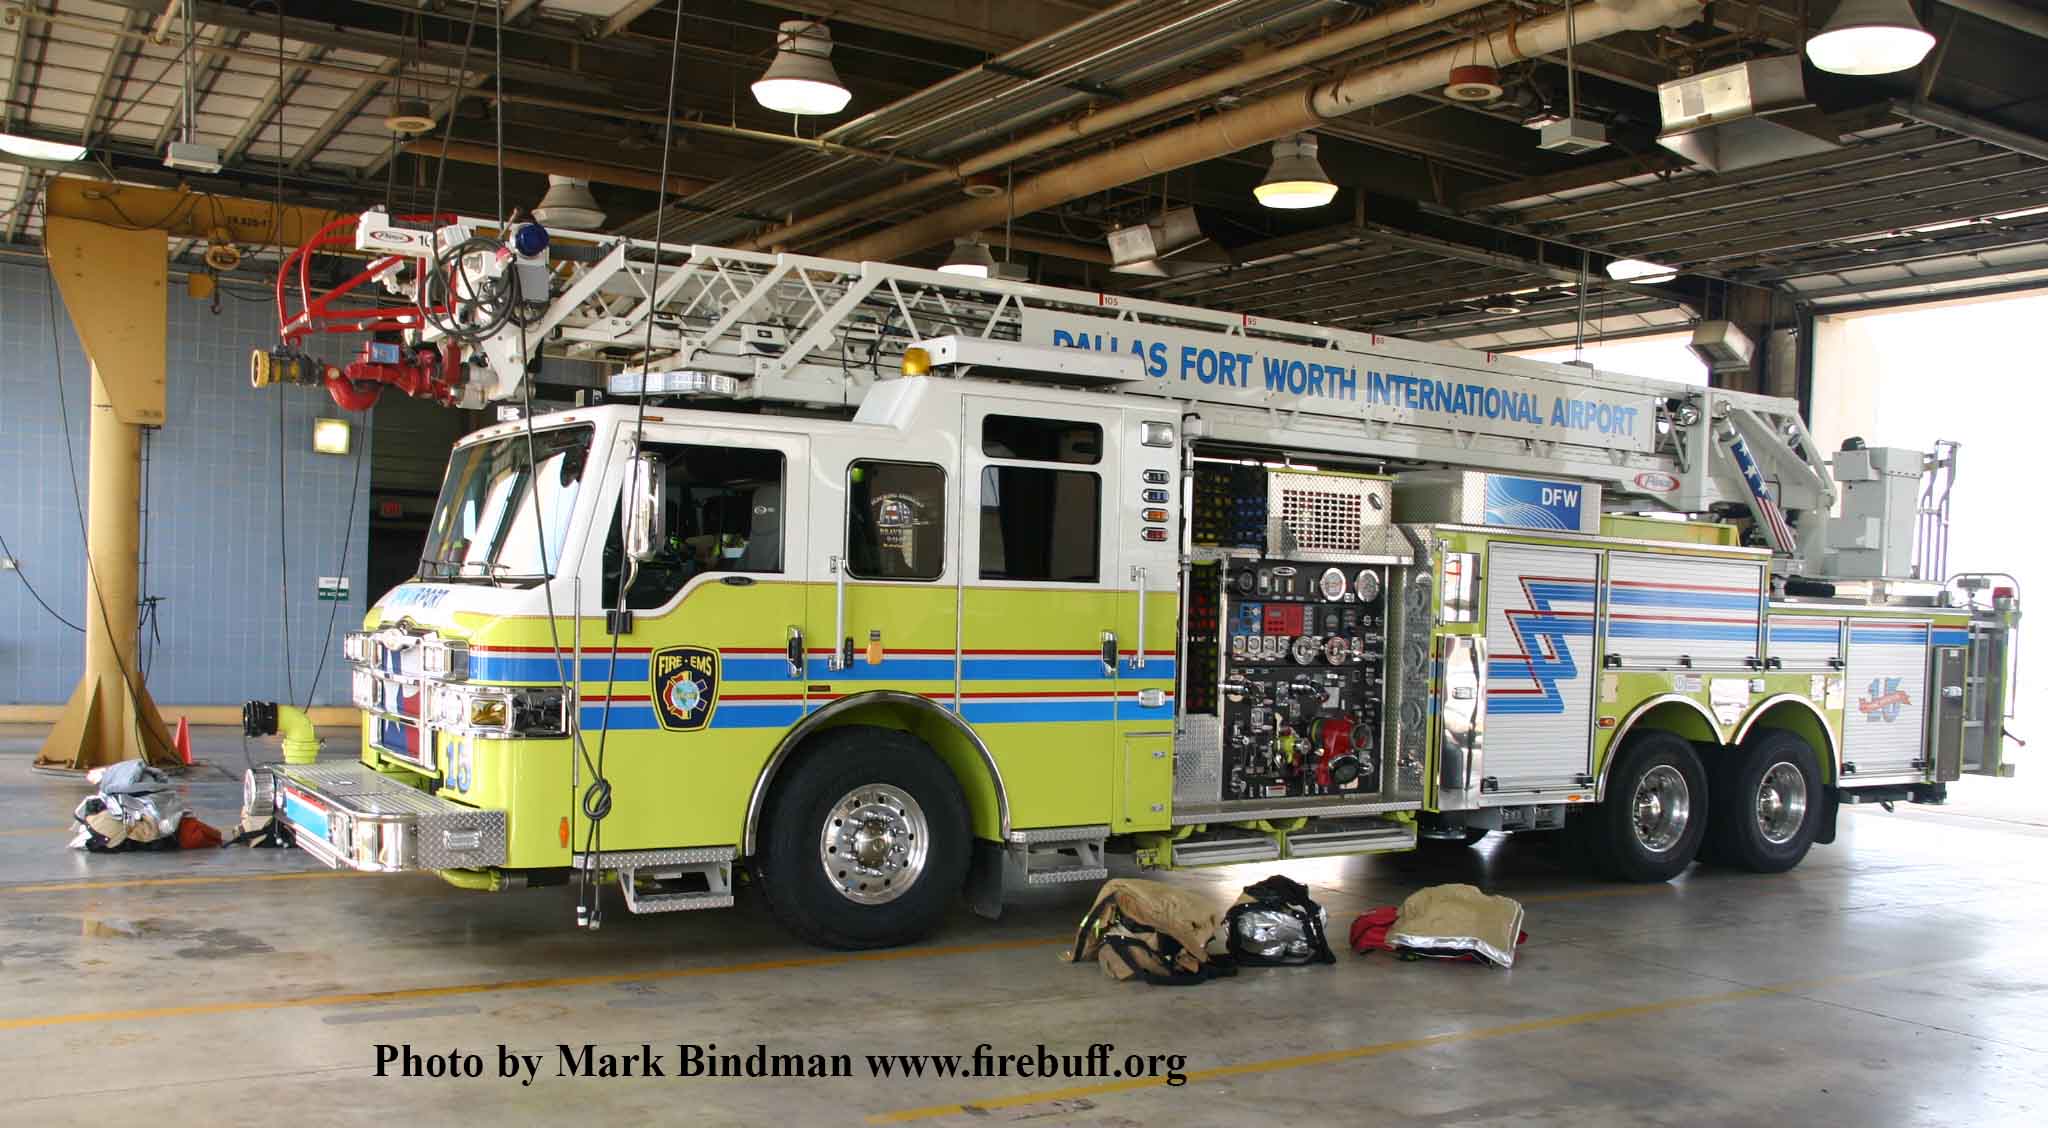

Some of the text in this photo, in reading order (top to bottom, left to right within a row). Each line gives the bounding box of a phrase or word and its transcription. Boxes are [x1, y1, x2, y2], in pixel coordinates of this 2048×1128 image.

[1105, 296, 1119, 305] 105
[1180, 346, 1253, 388] FORT
[1263, 356, 1357, 400] WORTH
[1367, 371, 1543, 425] INTERNATIONAL
[1551, 397, 1638, 437] AIRPORT
[1541, 487, 1578, 508] DFW
[658, 655, 712, 678] FIRE EMS
[446, 740, 472, 794] 15
